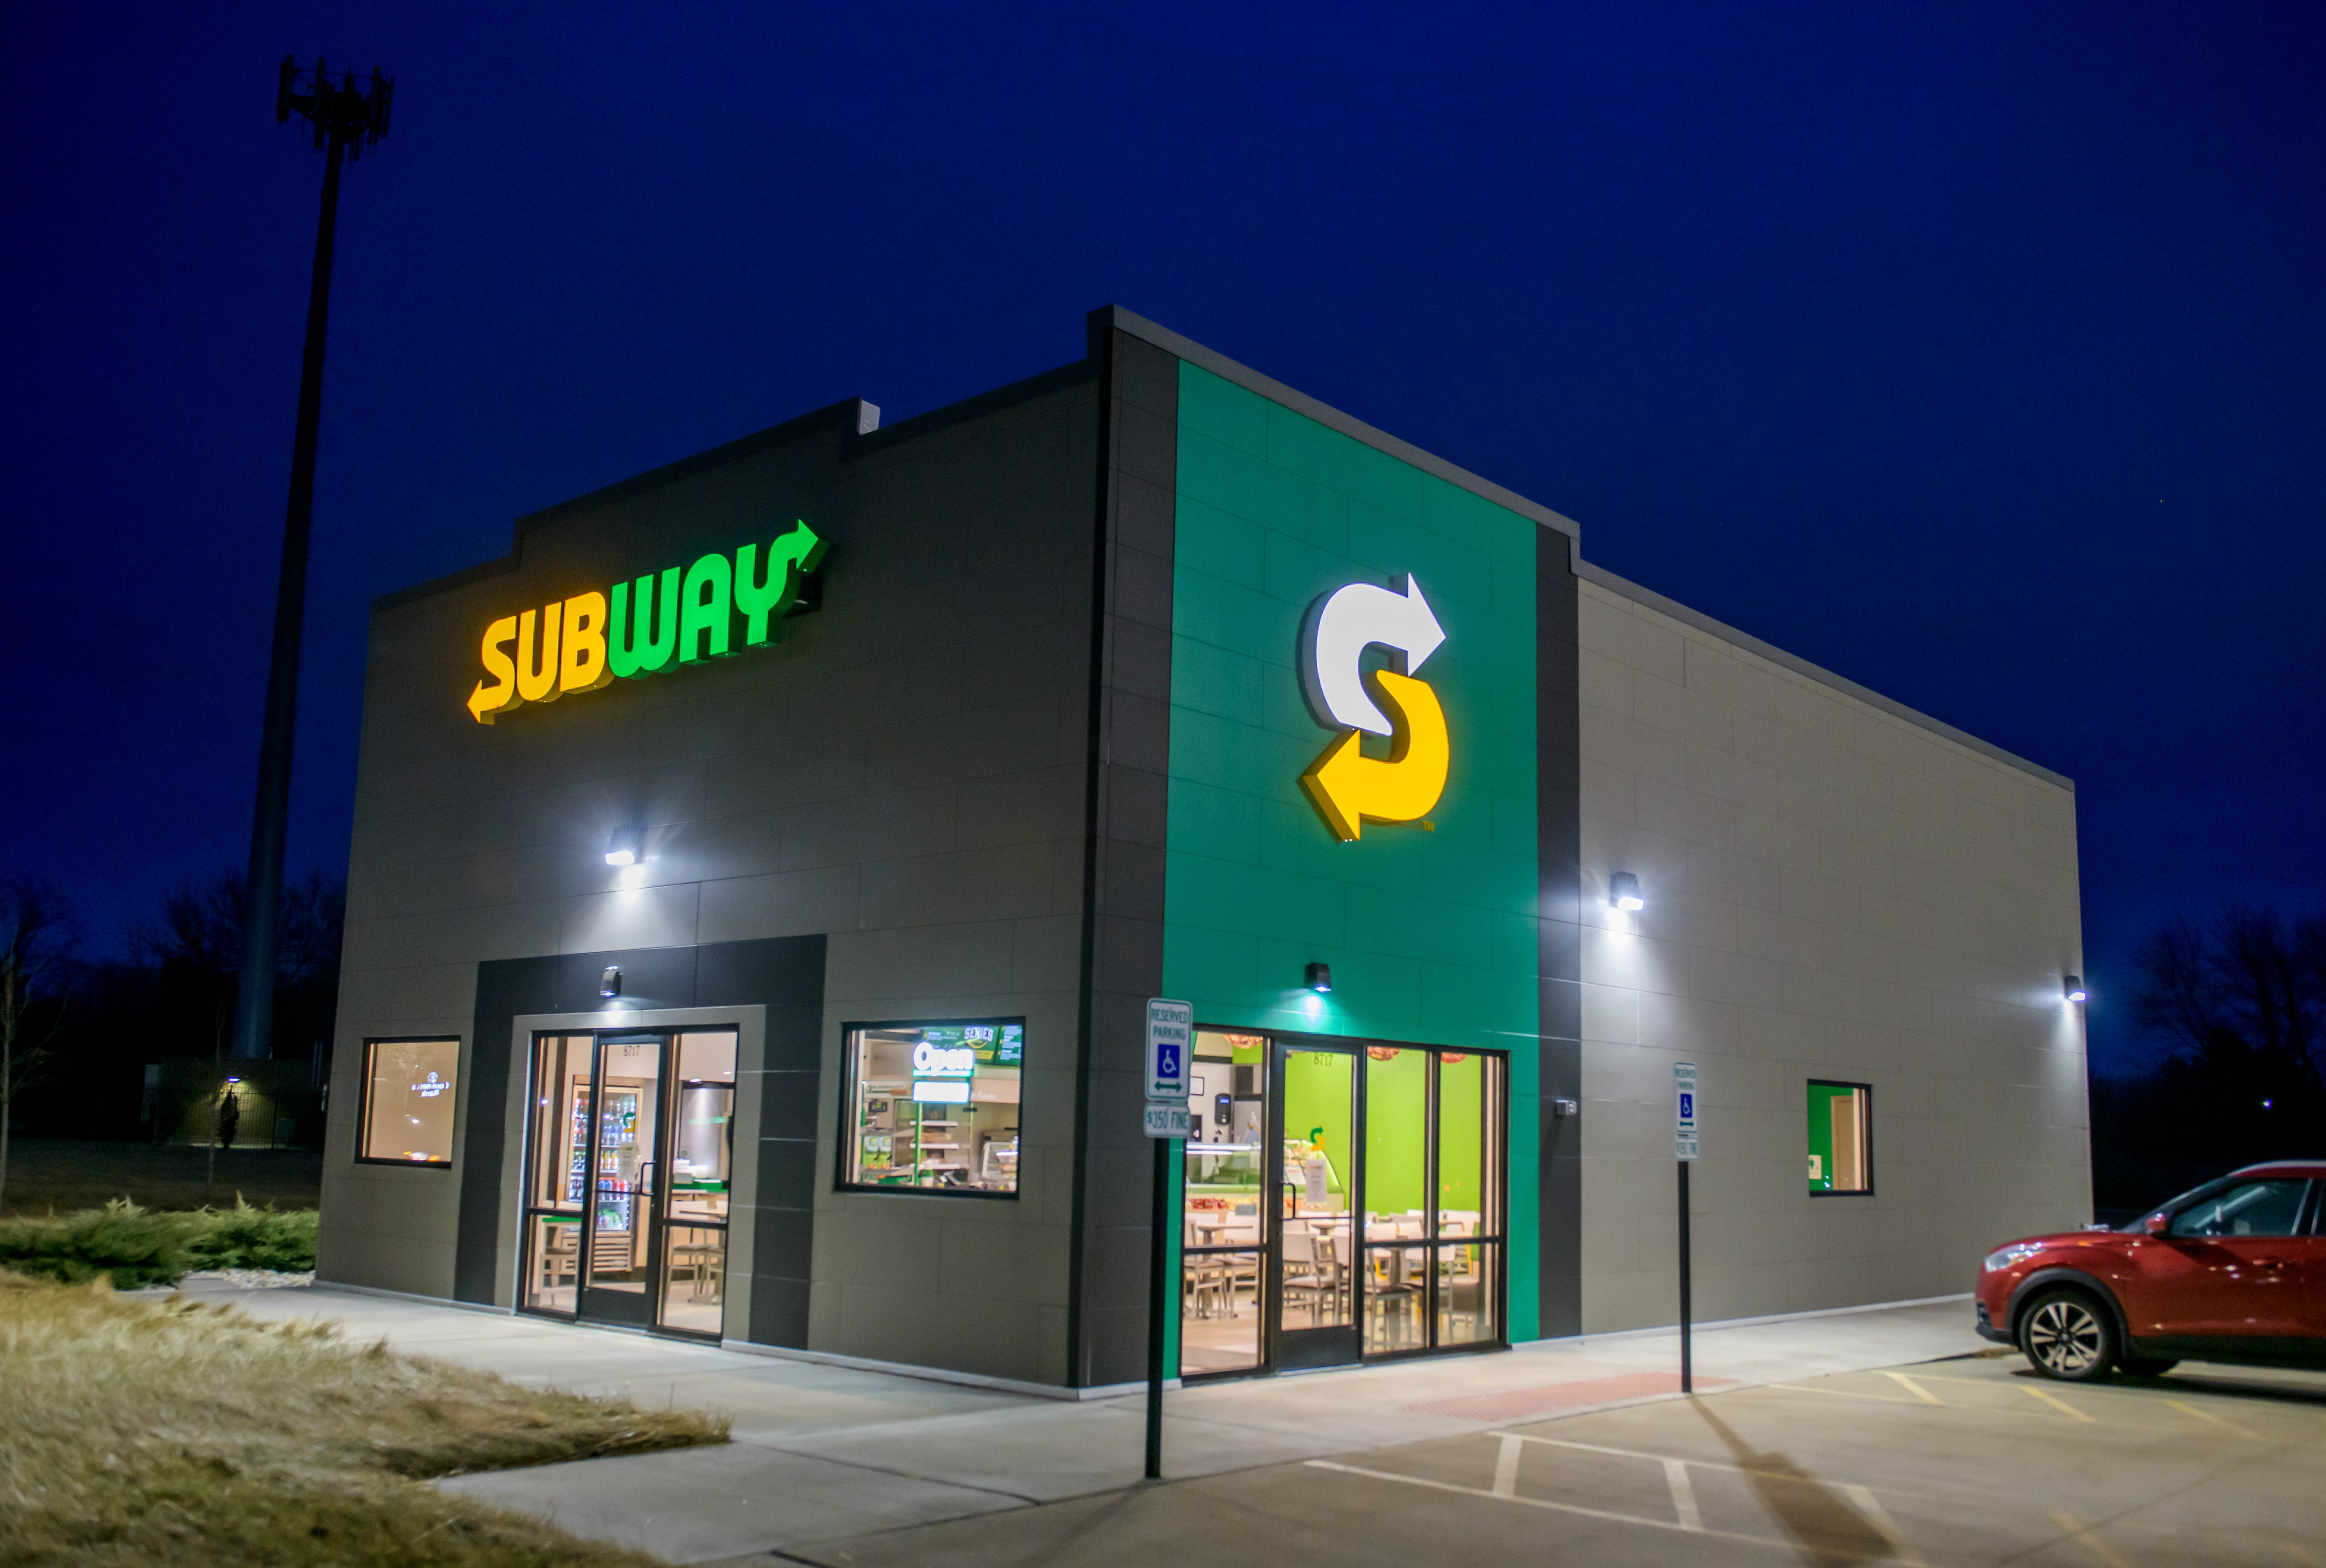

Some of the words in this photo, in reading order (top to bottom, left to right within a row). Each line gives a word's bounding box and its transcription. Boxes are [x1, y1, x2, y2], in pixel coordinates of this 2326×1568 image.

[467, 518, 820, 724] SUBWAY
[1151, 1009, 1188, 1024] RESERVED
[1153, 1026, 1186, 1040] PARKING
[623, 1045, 640, 1057] 8717
[914, 1042, 973, 1076] Open
[1314, 1052, 1333, 1067] 8717
[1171, 1111, 1188, 1129] FINE
